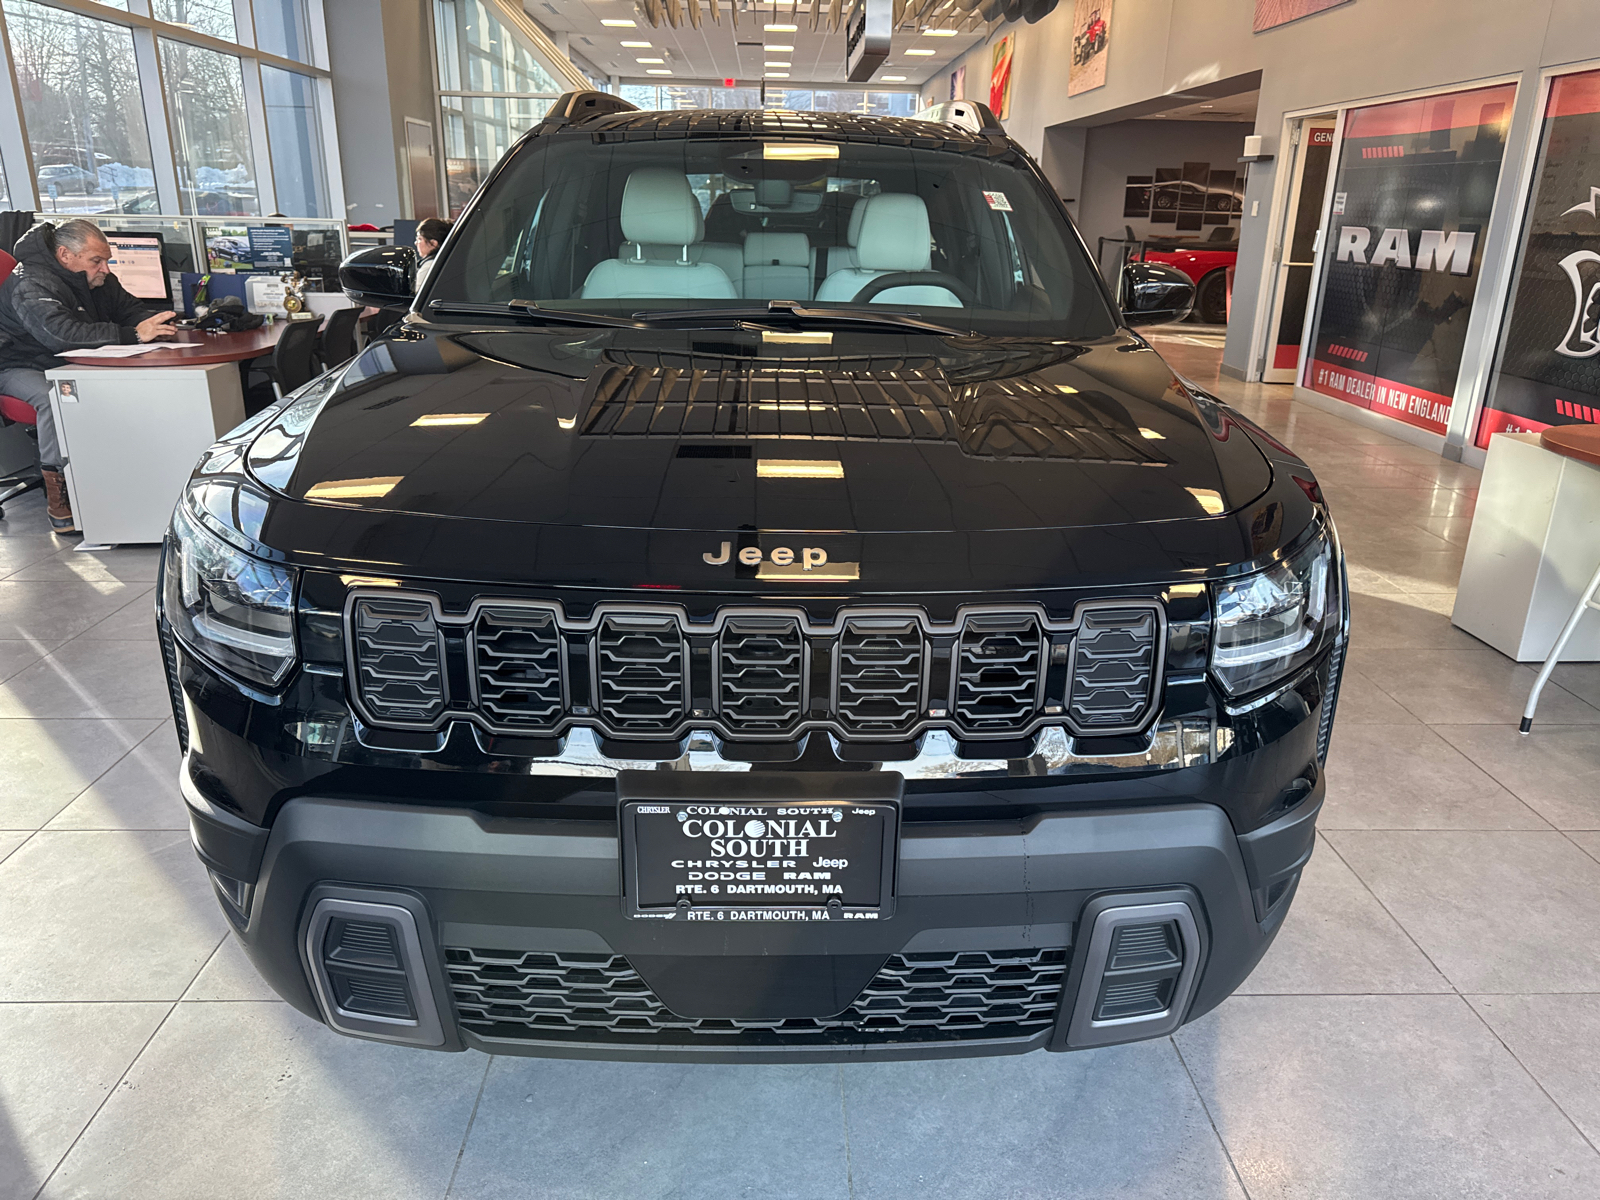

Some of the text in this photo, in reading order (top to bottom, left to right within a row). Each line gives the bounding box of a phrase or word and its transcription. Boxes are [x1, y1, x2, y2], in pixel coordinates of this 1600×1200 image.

[1314, 131, 1334, 143] GEN
[1336, 225, 1476, 275] RAM
[1318, 368, 1452, 425] #1 RAM DEALER IN NEW ENGLAND
[702, 541, 828, 571] Jeep
[637, 806, 671, 814] CHRYSLER
[686, 806, 835, 816] COLONIAL SOUTH
[851, 808, 876, 816] Jeep
[682, 819, 837, 838] COLONIAL
[710, 838, 810, 858] SOUTH
[671, 856, 849, 870] CHRYSLER Jeep
[688, 871, 832, 881] DODGE RAM
[675, 884, 844, 896] RTE. 6 DARTMOUTH, MA
[687, 911, 831, 921] RTE. 6 DARTMOUTH, MA
